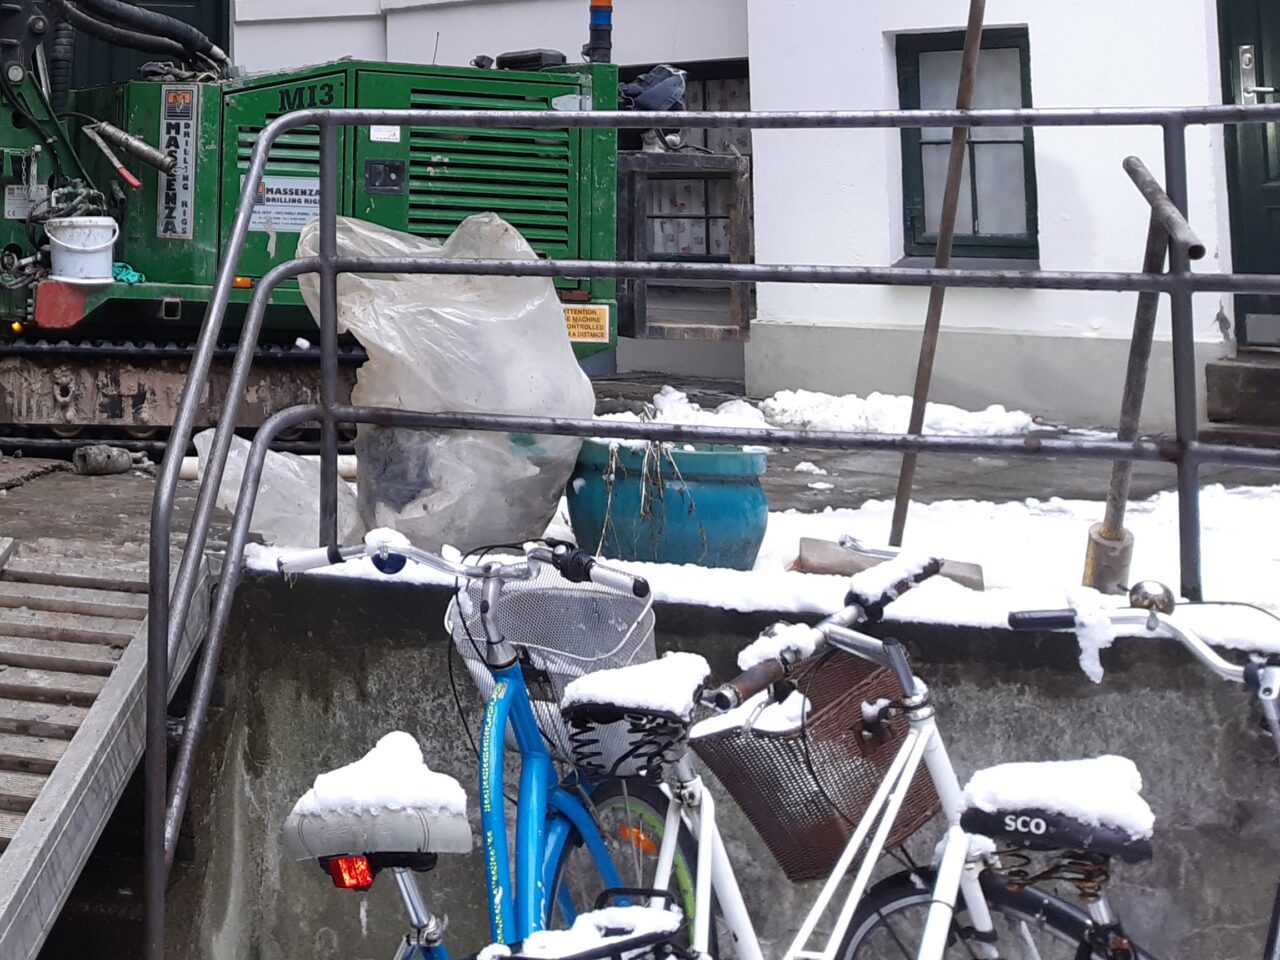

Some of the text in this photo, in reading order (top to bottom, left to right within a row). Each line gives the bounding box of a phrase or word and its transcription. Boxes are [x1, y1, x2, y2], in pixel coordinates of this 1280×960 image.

[163, 122, 181, 234] MASENZA
[182, 122, 191, 190] DRILLING
[265, 187, 320, 197] MASSENZA
[1004, 814, 1047, 835] SCO
